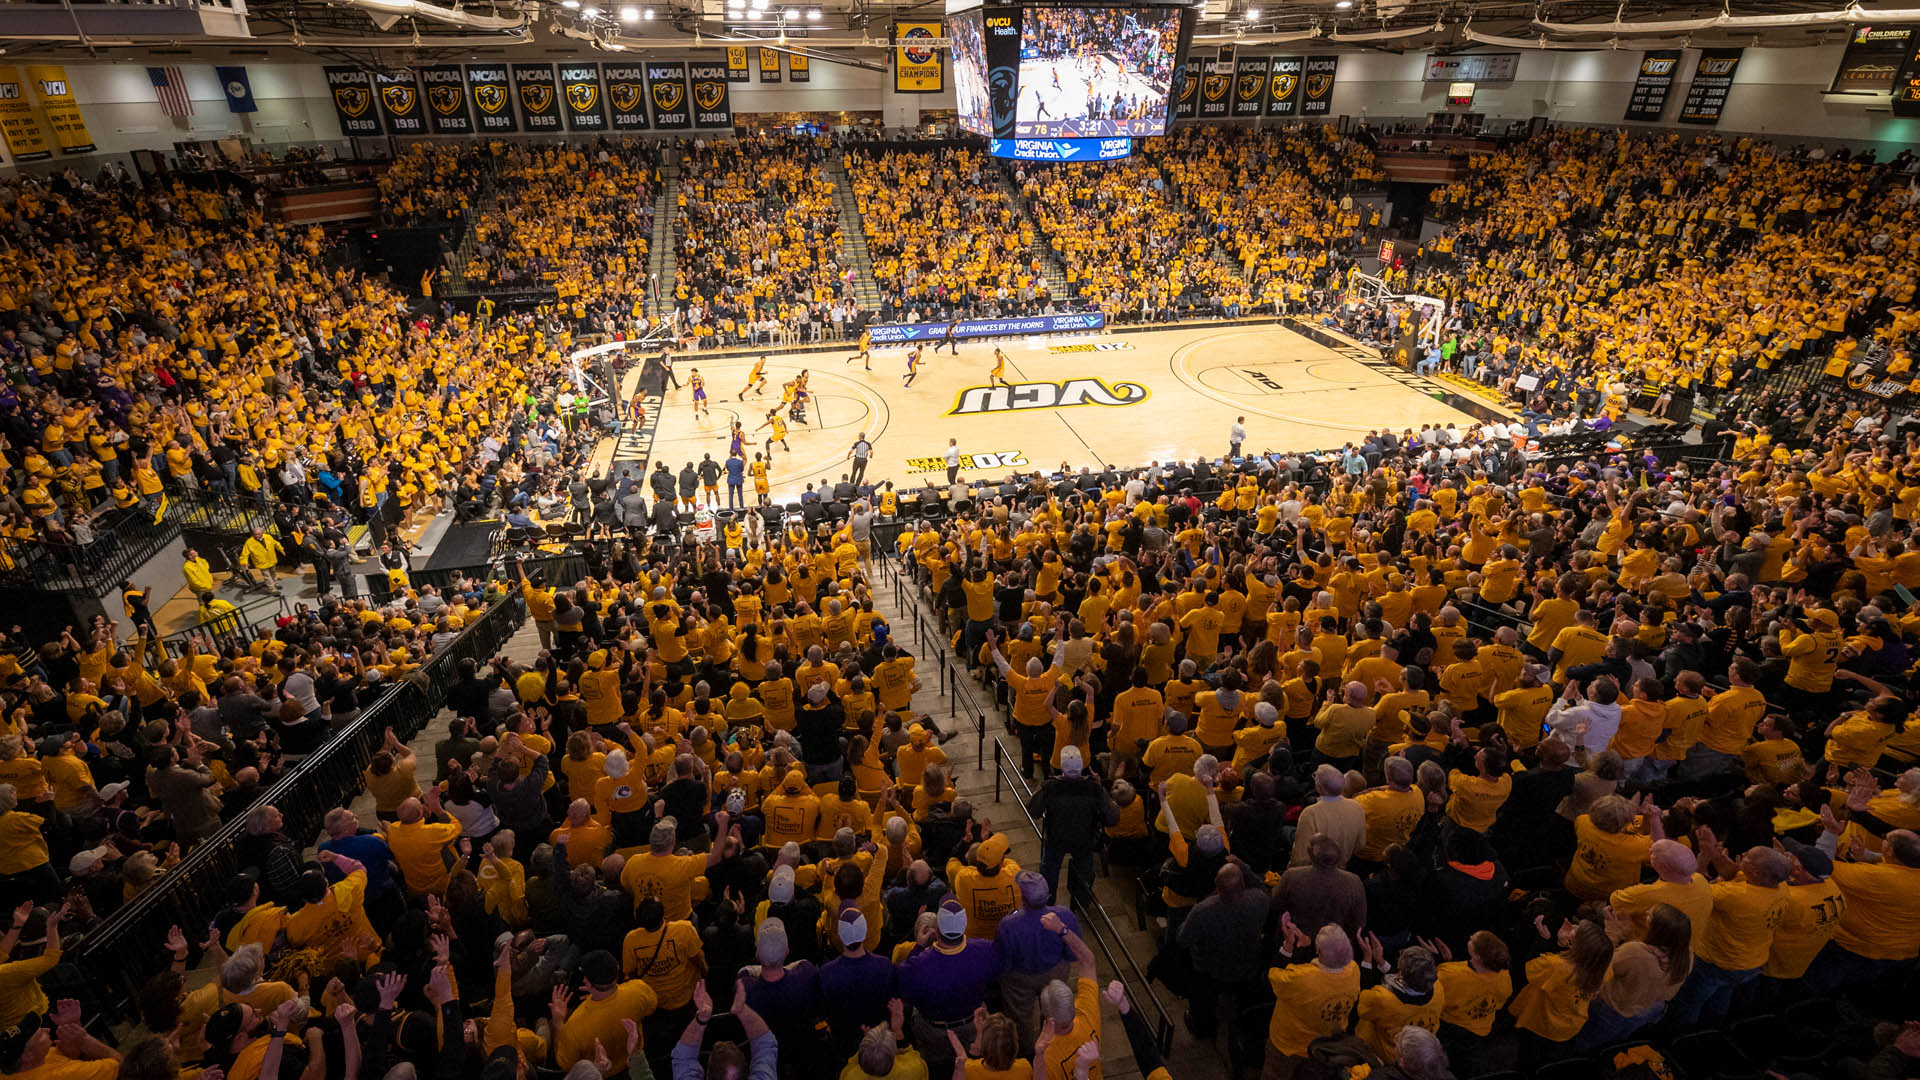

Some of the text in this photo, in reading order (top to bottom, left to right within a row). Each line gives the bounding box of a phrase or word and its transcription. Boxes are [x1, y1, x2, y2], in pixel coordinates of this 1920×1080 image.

[993, 18, 1011, 27] VCU
[995, 27, 1018, 36] Health.
[1238, 62, 1267, 72] NCAA
[1273, 62, 1301, 72] NCAA
[1307, 61, 1336, 71] NCAA
[328, 71, 369, 84] NCAA
[423, 70, 462, 83] NCAA
[469, 70, 507, 82] NCAA
[516, 69, 553, 81] NCAA
[562, 69, 598, 81] NCAA
[606, 68, 641, 80] NCAA
[649, 68, 684, 79] NCAA
[691, 67, 726, 79] NCAA
[900, 70, 939, 78] CHAMPIONS
[41, 80, 67, 96] VCU
[1271, 102, 1293, 111] 2017
[1306, 101, 1326, 110] 2019
[1688, 97, 1702, 105] NIT
[1177, 104, 1192, 113] 014
[1204, 103, 1225, 112] 2015
[1238, 103, 1259, 111] 2016
[438, 118, 467, 128] 1983
[483, 116, 510, 127] 1984
[529, 116, 557, 126] 1985
[616, 114, 645, 124] 2004
[658, 113, 686, 124] 2007
[699, 112, 727, 123] 2009
[346, 119, 375, 130] 1980
[394, 118, 420, 129] 1981
[1079, 119, 1102, 131] 3:21
[1133, 122, 1146, 134] 71
[1035, 124, 1048, 136] 76
[1015, 139, 1054, 151] VIRGINIA
[1014, 149, 1060, 159] Credit Union.
[1054, 315, 1084, 325] VIRGINIA
[928, 327, 947, 336] GRAB
[966, 324, 998, 333] FINANCES
[998, 322, 1007, 332] BY
[1007, 321, 1020, 331] THE
[1021, 320, 1045, 330] HORNS
[1053, 322, 1071, 330] Credit
[869, 327, 902, 338] VIRGINIA
[1094, 341, 1136, 352] 20
[948, 378, 1147, 414] VCU
[971, 451, 1029, 469] 20
[1824, 648, 1839, 664] 2
